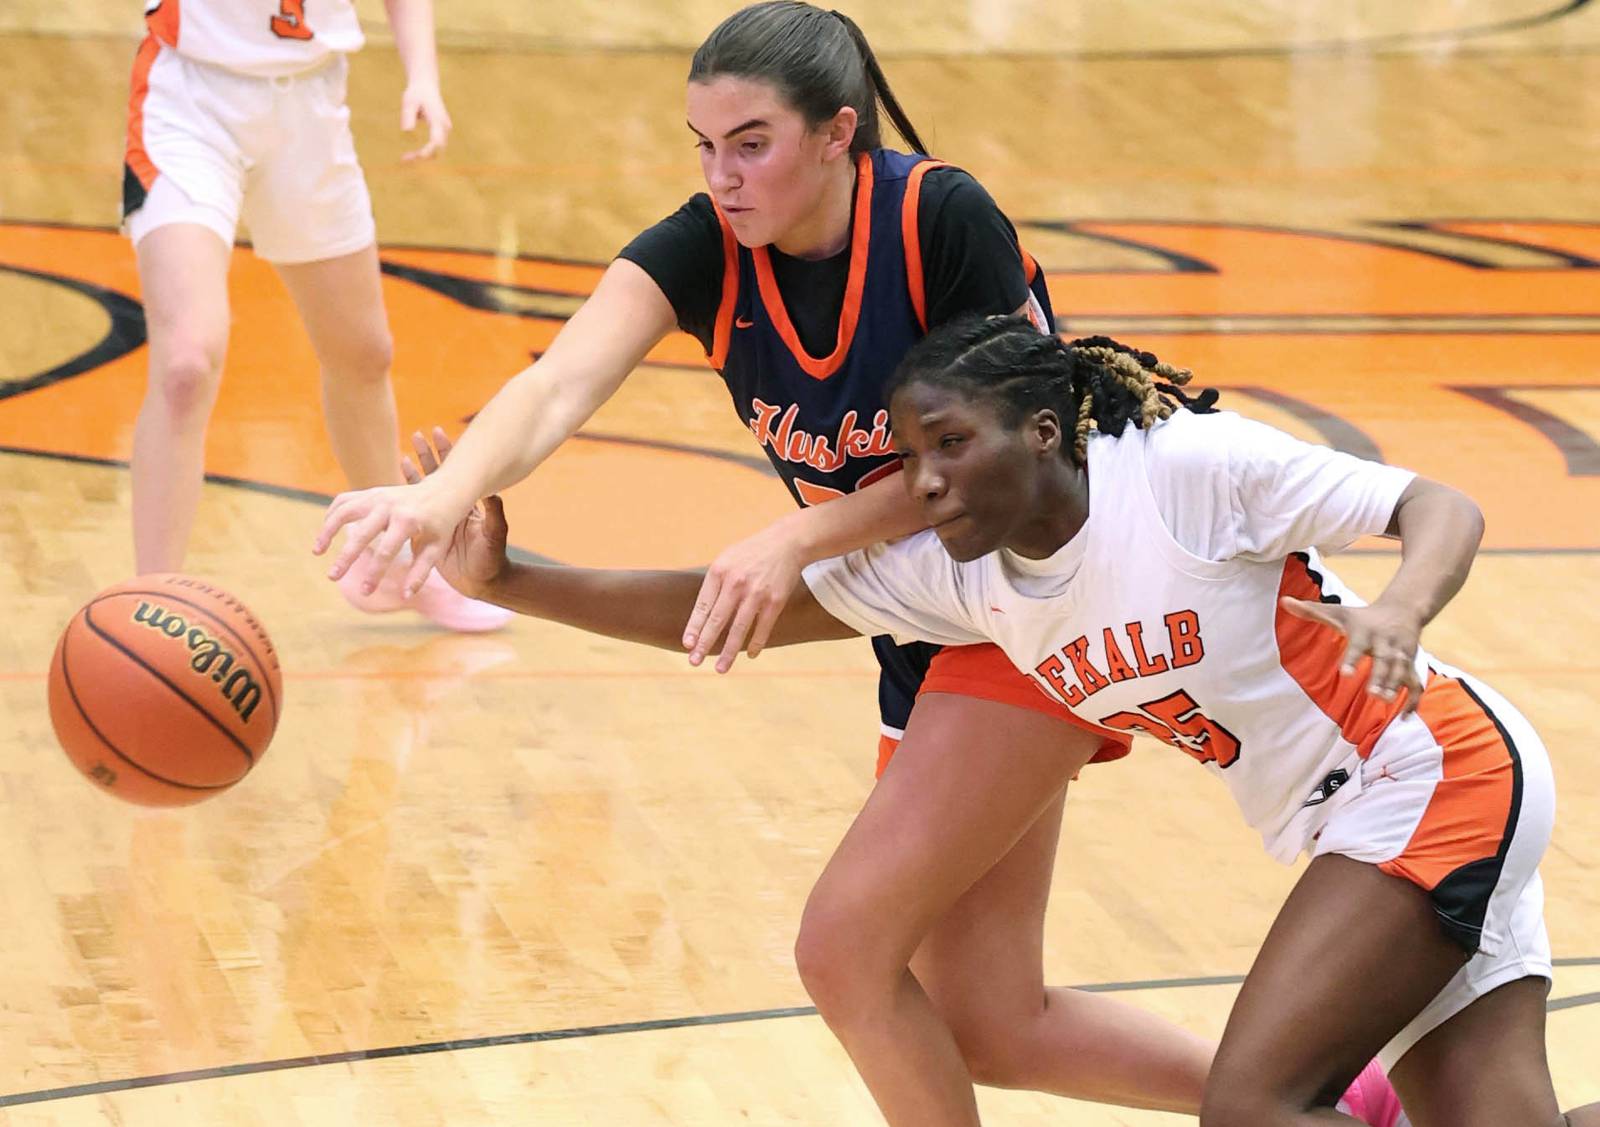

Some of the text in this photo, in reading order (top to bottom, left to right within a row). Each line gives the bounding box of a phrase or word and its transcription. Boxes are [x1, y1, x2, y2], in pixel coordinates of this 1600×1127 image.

[750, 397, 897, 473] Huski
[133, 600, 263, 725] Wilson
[1025, 609, 1205, 708] EKALB
